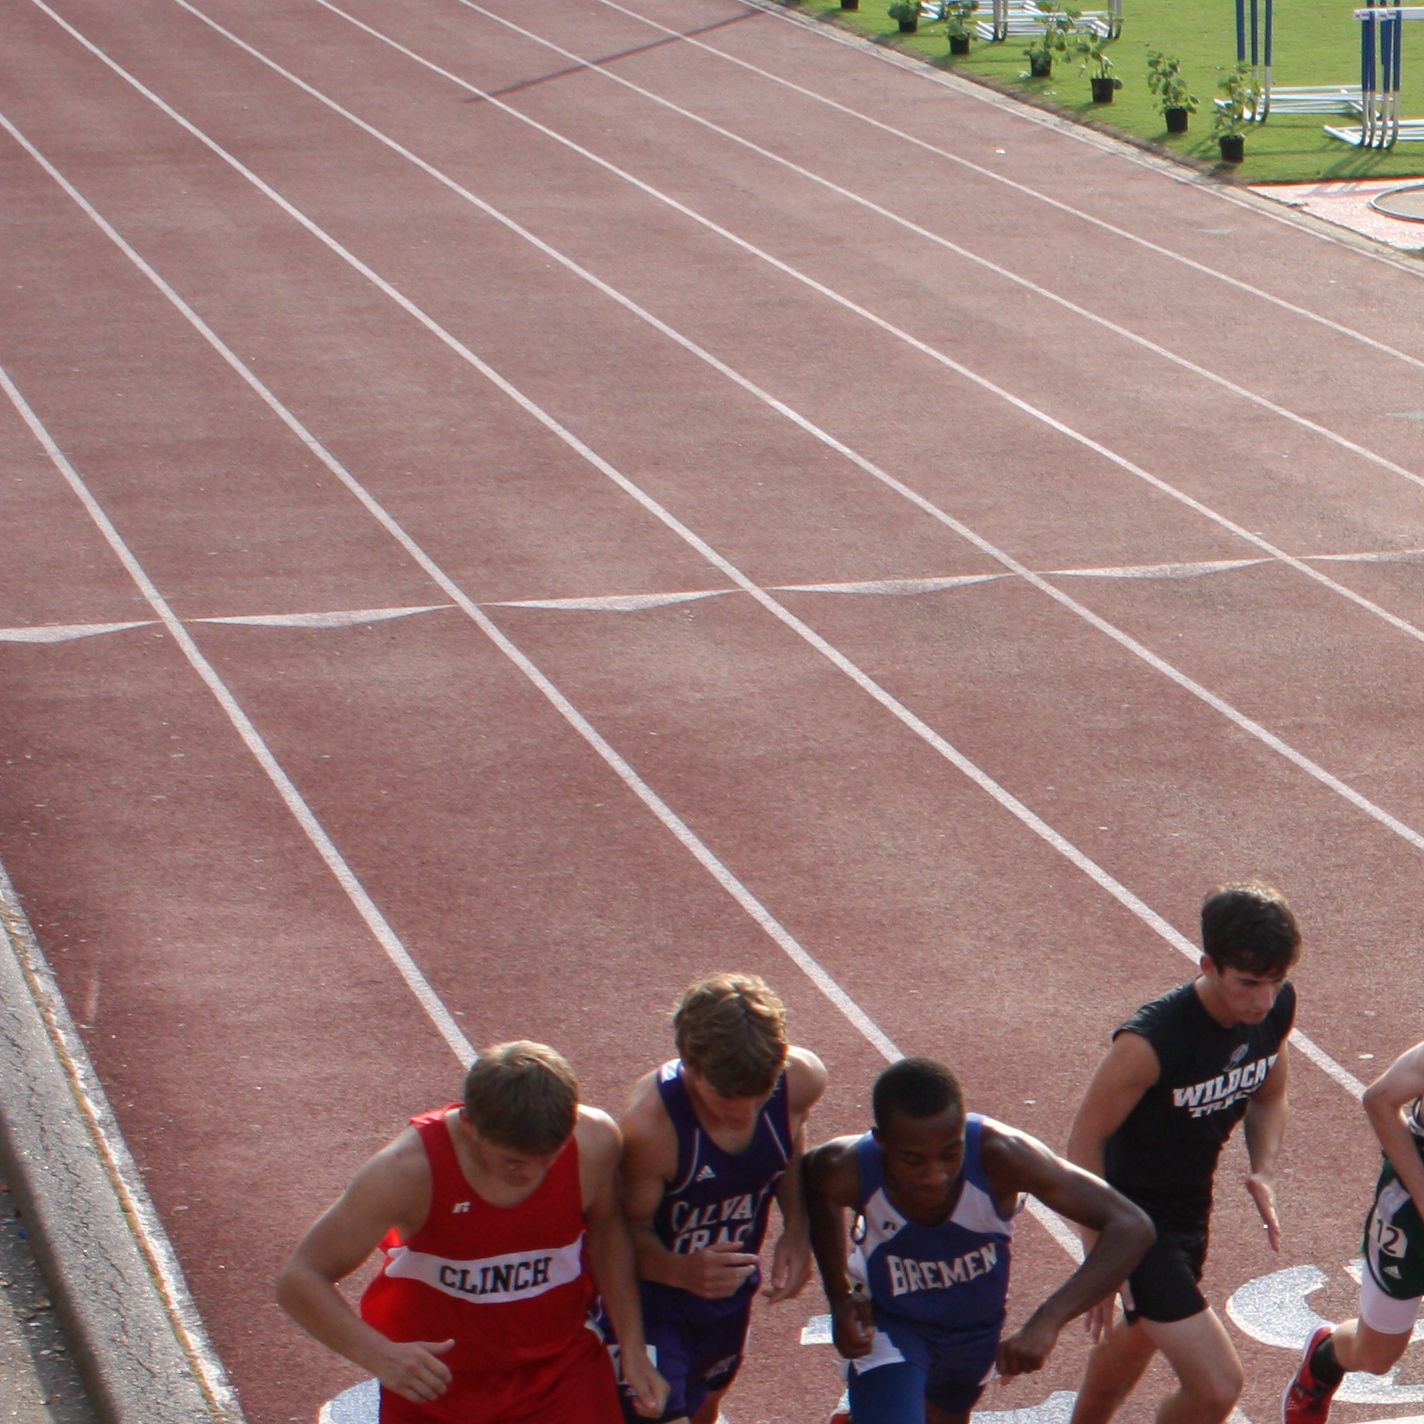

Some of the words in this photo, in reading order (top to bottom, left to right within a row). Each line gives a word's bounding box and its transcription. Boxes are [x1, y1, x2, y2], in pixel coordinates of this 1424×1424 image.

[1376, 1218, 1401, 1254] 12
[439, 1256, 552, 1296] CLINCH
[886, 1242, 998, 1297] BREMEN
